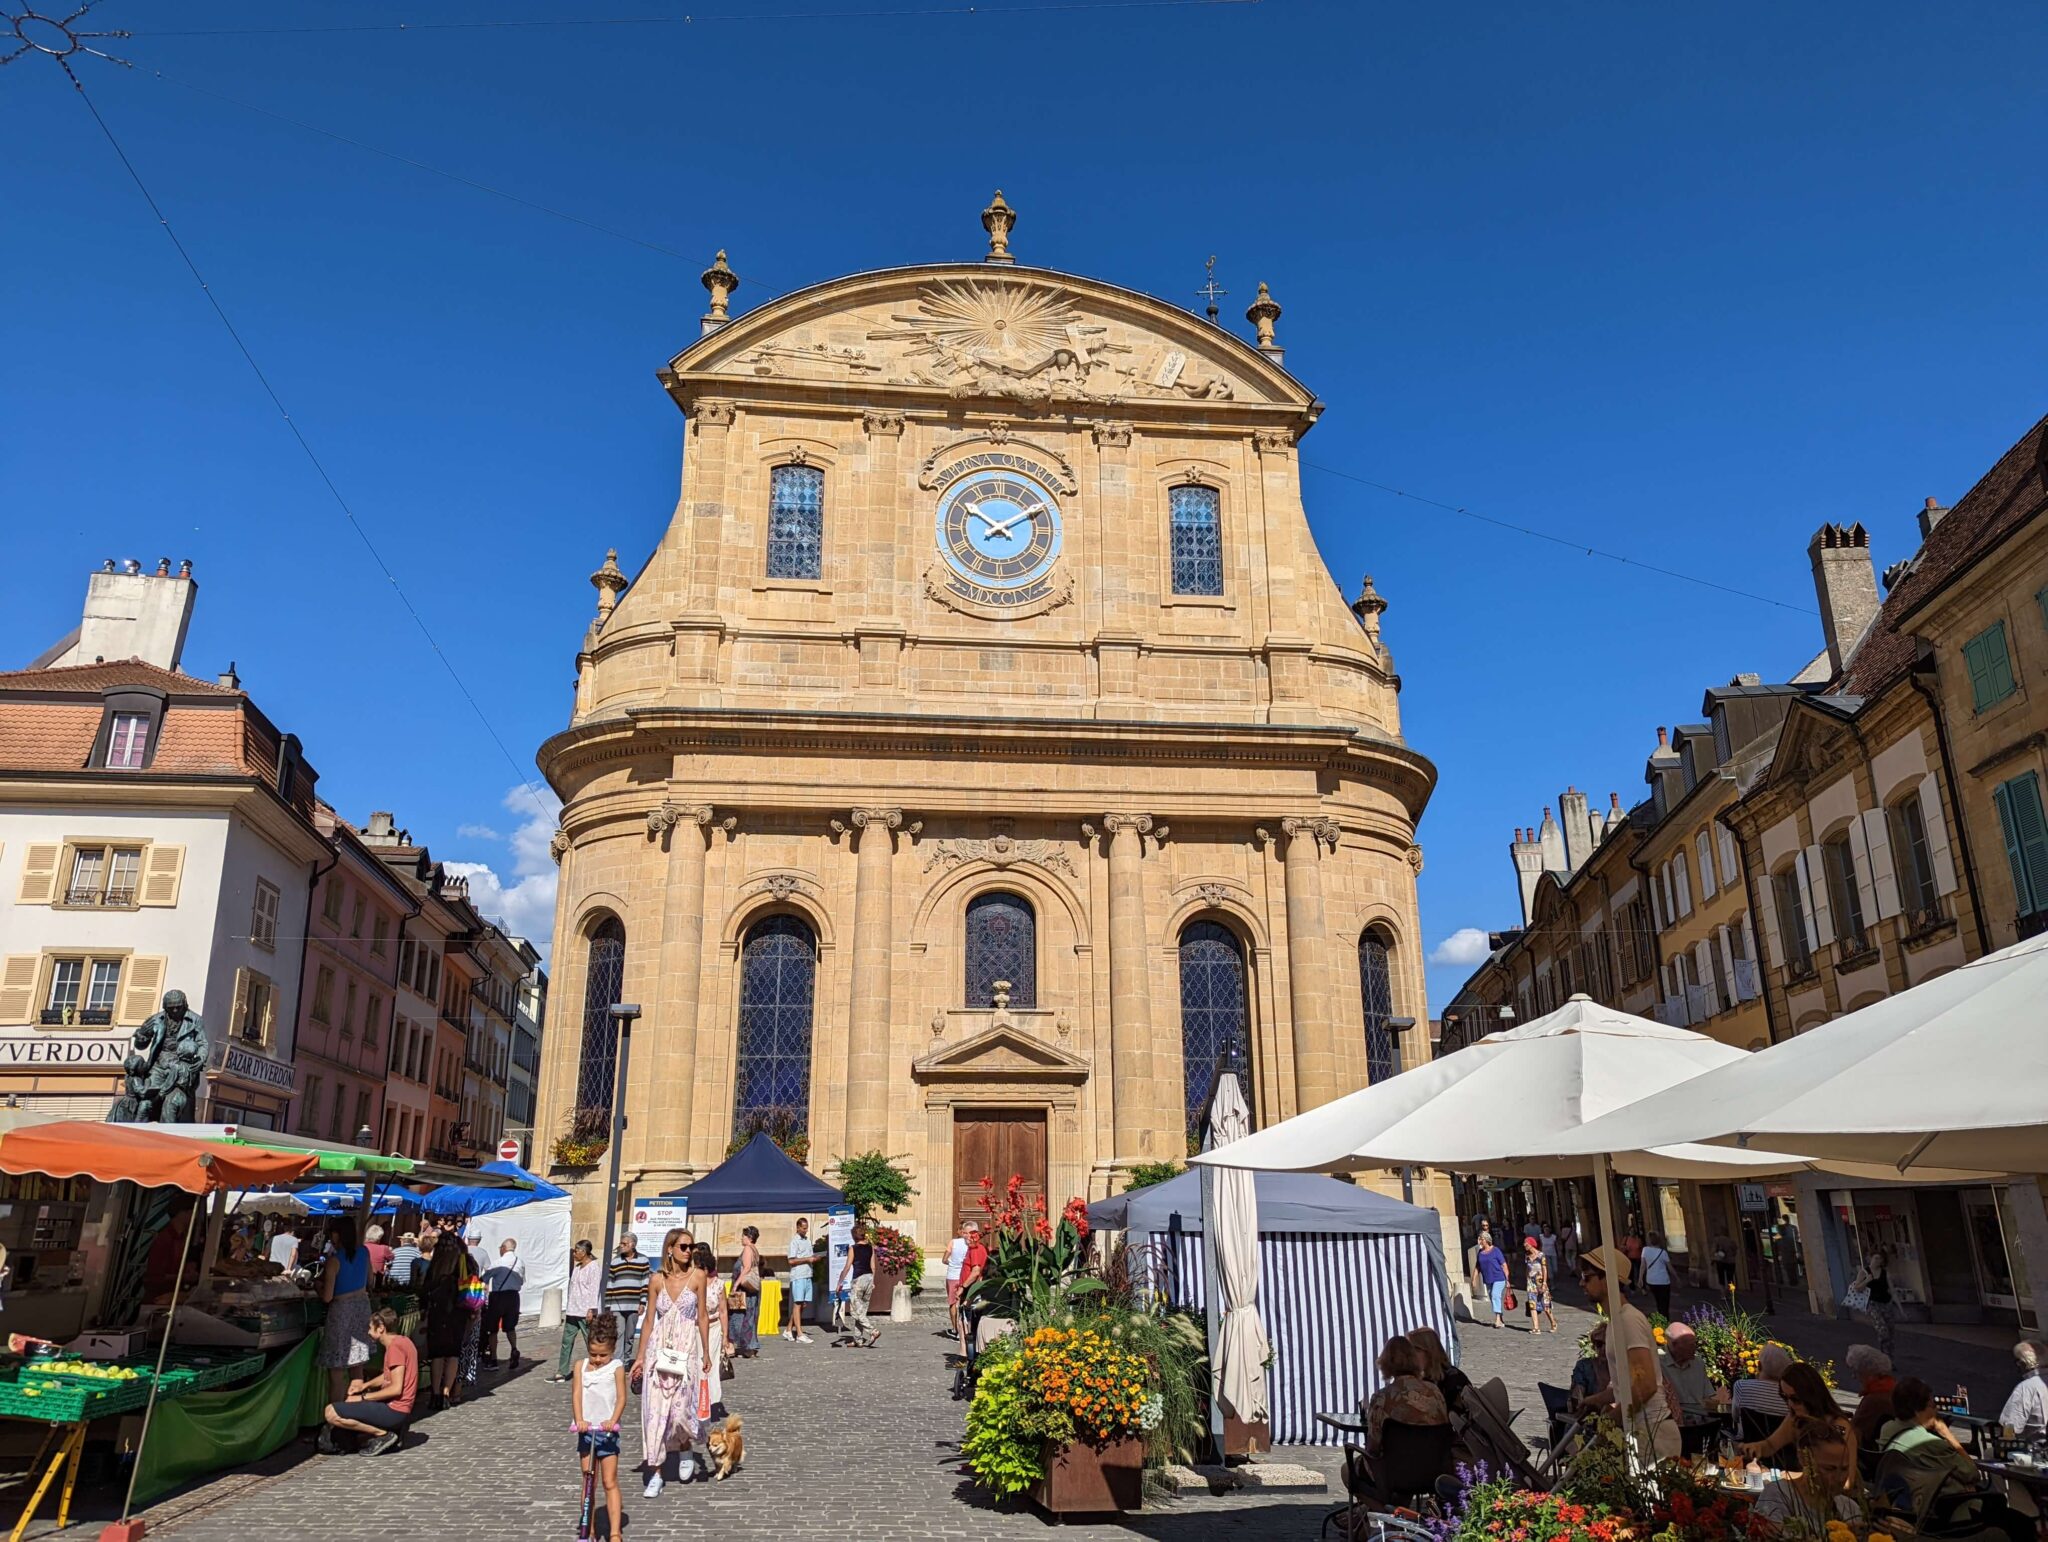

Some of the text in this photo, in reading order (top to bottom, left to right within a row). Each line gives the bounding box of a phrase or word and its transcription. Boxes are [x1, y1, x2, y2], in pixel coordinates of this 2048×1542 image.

[936, 454, 994, 490] SVPERNA
[966, 585, 1032, 605] MDCCLV
[226, 1051, 253, 1075] BAZAR
